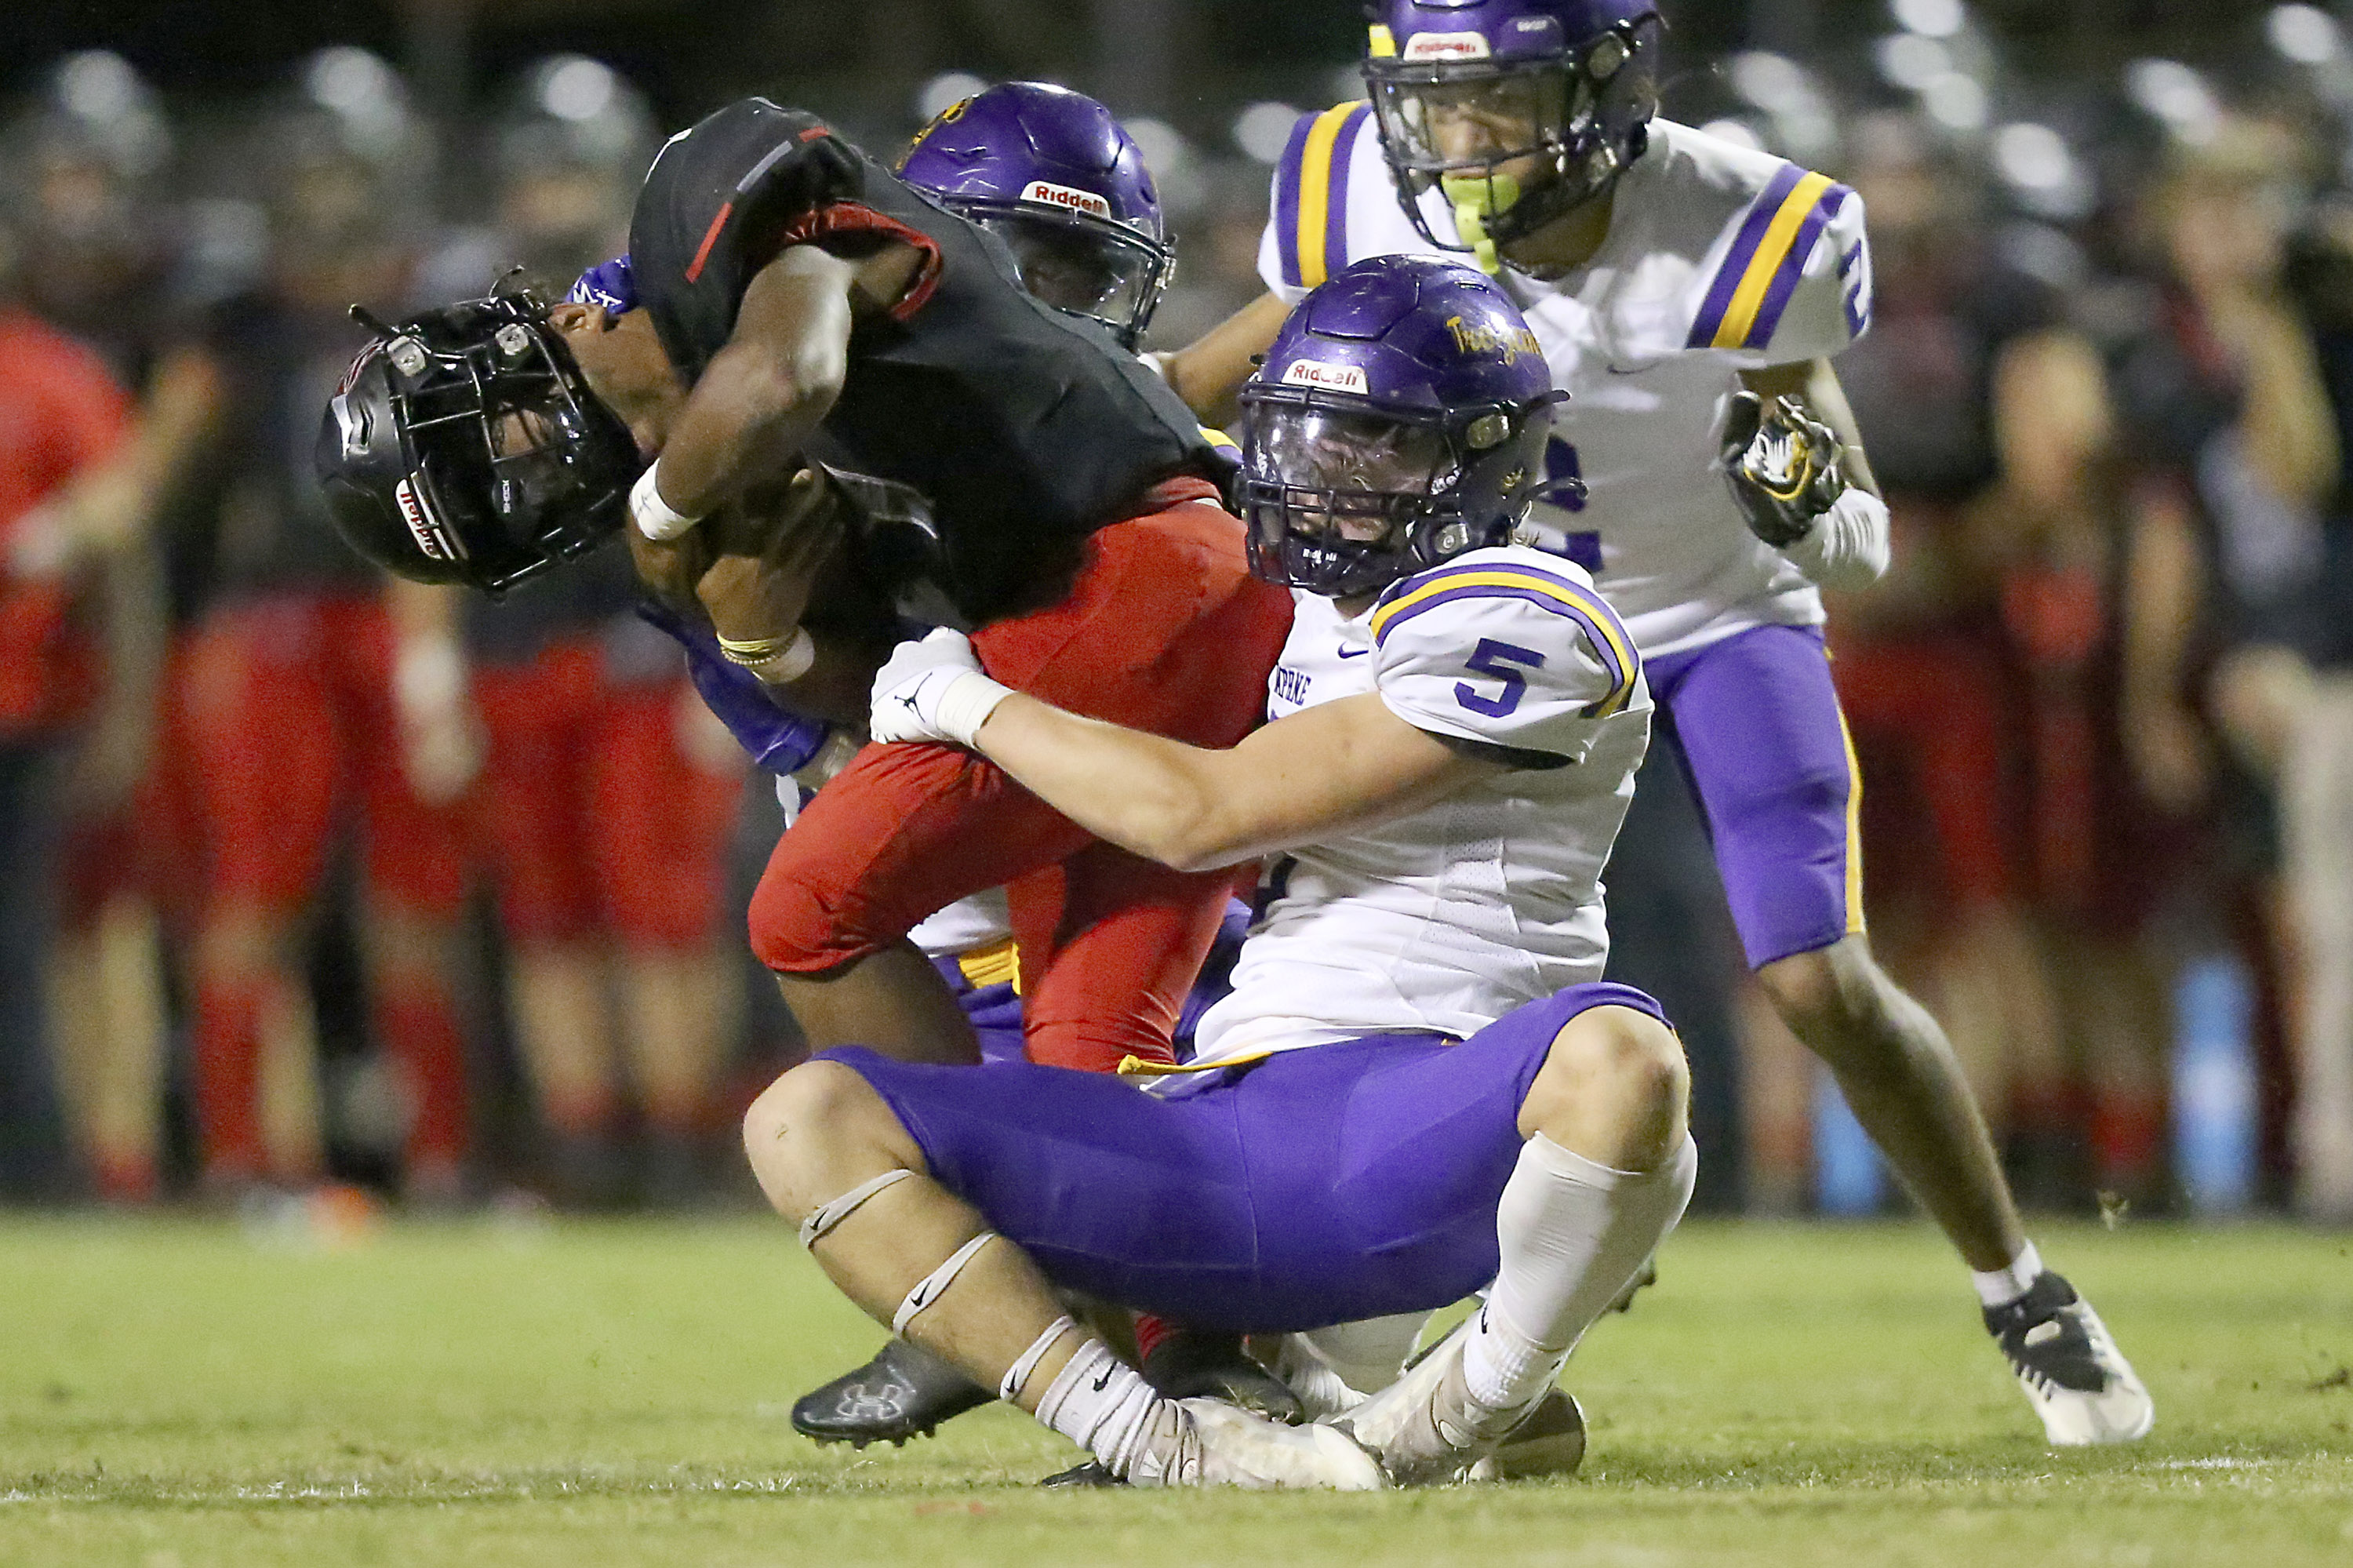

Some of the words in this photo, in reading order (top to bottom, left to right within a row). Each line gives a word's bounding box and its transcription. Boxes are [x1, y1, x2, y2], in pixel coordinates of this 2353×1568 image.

[1036, 186, 1103, 213] Riddell
[1274, 666, 1311, 706] APHNE
[1453, 638, 1547, 718] 5
